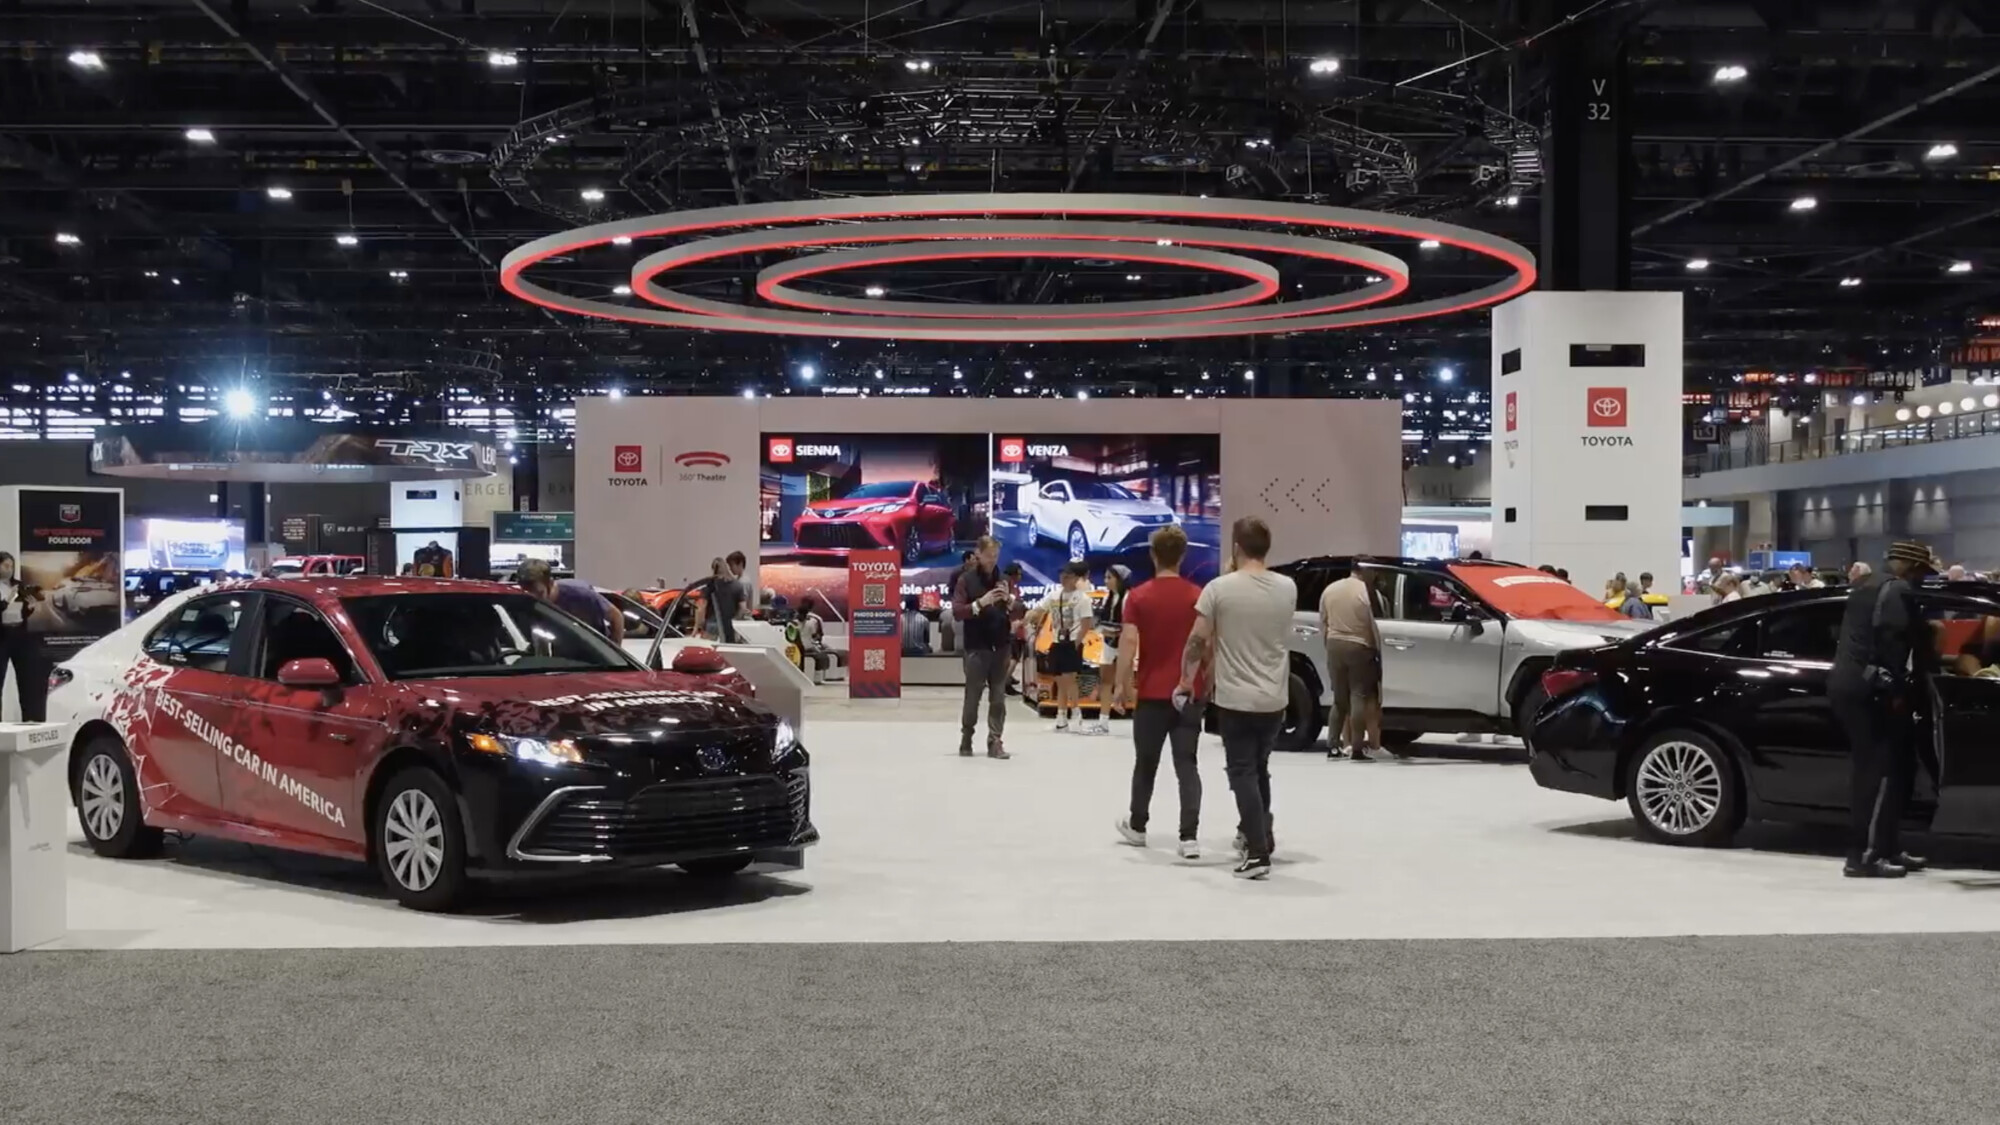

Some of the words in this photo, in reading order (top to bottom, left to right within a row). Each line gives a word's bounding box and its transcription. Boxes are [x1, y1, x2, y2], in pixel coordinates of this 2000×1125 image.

[1592, 78, 1606, 96] V
[1587, 103, 1611, 120] 32
[1580, 436, 1634, 447] TOYOTA
[374, 439, 474, 463] TRX
[795, 445, 842, 456] SIENNA
[1026, 445, 1069, 456] VENZA
[607, 478, 648, 486] TOYOTA
[697, 473, 727, 481] Theater
[48, 536, 69, 545] FOUR
[70, 536, 92, 545] DOOR
[852, 562, 897, 572] TOYOTA
[583, 701, 614, 712] IN
[614, 696, 713, 707] AMERICA
[154, 687, 233, 756] BEST-SELLING
[234, 743, 260, 776] CAR
[261, 760, 279, 787] IN
[279, 773, 346, 828] AMERICA
